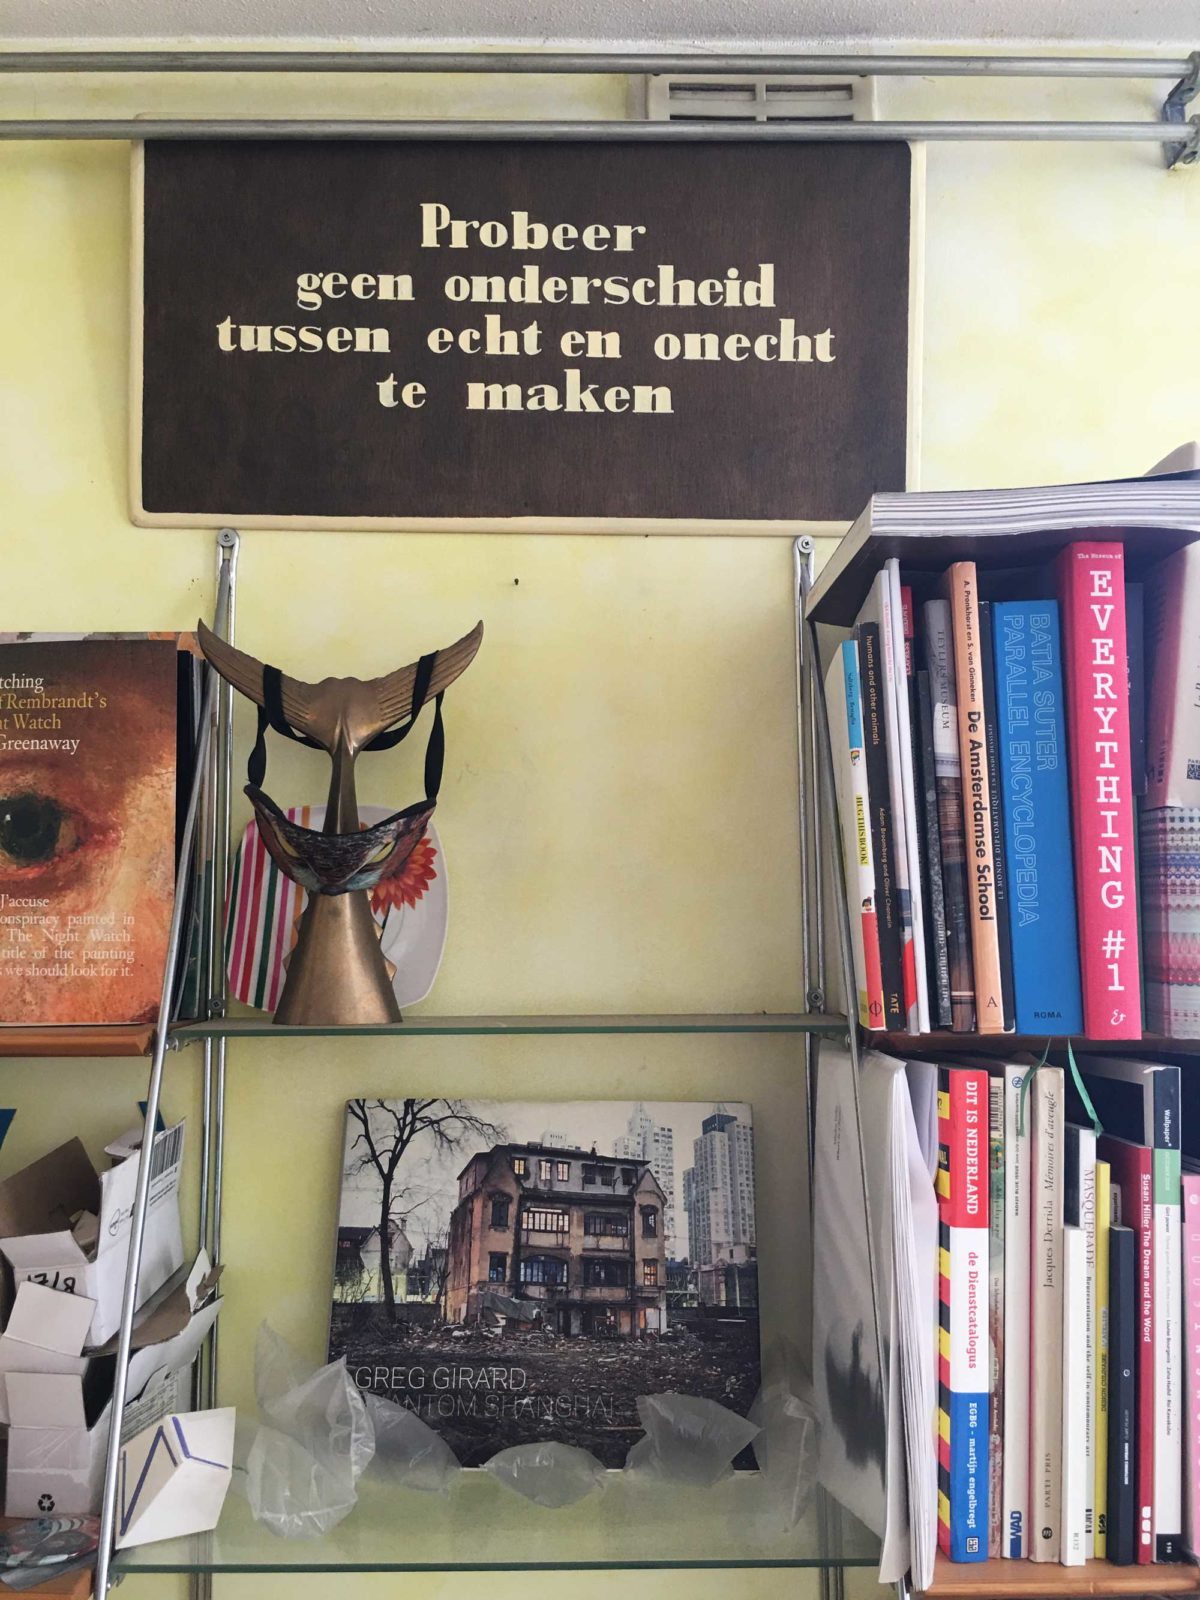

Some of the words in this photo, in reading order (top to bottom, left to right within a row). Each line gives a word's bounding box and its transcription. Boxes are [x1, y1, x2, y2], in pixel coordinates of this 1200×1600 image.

[420, 203, 646, 251] Probeer
[297, 272, 415, 311] geen
[444, 263, 776, 307] onderscheid
[216, 315, 391, 353] tussen
[427, 314, 542, 355] echt
[560, 330, 622, 358] en
[654, 318, 836, 362] onecht
[376, 372, 427, 408] te
[466, 368, 674, 413] maken
[963, 591, 973, 630] Pronkhorst
[866, 635, 876, 668] humans
[966, 631, 973, 641] en
[1029, 613, 1053, 685] BATIA
[869, 670, 877, 687] and
[968, 668, 977, 702] Ginneken
[1003, 614, 1029, 734] PARALLEL
[7, 692, 107, 709] Rembrandt's
[870, 688, 878, 710] other
[940, 682, 950, 729] MUSEUM
[14, 713, 62, 729] Watch
[871, 712, 880, 745] animals
[968, 711, 981, 733] De
[1033, 690, 1058, 771] SUTER
[1089, 570, 1126, 909] EVERYTHING
[969, 739, 988, 858] Amsterdamse
[991, 790, 1001, 853] DIPLOMATIQUE
[1009, 741, 1040, 927] ENCYCLOPEDIA
[880, 828, 889, 863] Broomberg
[977, 864, 994, 920] School
[68, 913, 115, 928] painted
[123, 912, 135, 925] in
[7, 929, 33, 942] The
[42, 929, 79, 945] Night
[2, 946, 26, 959] title
[33, 946, 48, 959] of
[54, 946, 74, 959] the
[82, 948, 135, 964] painting
[5, 967, 23, 976] we
[25, 963, 68, 977] should
[71, 963, 98, 977] look
[101, 963, 118, 977] for
[1102, 929, 1126, 991] #1
[890, 993, 900, 1014] TATE
[966, 1081, 978, 1105] DIT
[966, 1110, 978, 1123] IS
[1043, 1090, 1056, 1138] d'aveugle
[966, 1128, 978, 1214] NEDERLAND
[1043, 1143, 1054, 1191] Mémoires
[1143, 1173, 1151, 1201] Susan
[1043, 1200, 1054, 1242] Derrida
[1143, 1204, 1151, 1228] Hiller
[1143, 1230, 1151, 1247] The
[968, 1252, 979, 1267] de
[1043, 1247, 1056, 1288] Jacques
[1143, 1249, 1151, 1278] Dream
[1143, 1281, 1152, 1299] and
[966, 1271, 979, 1369] Dienstcatalogus
[1143, 1300, 1152, 1315] the
[1143, 1317, 1152, 1342] Word
[355, 1366, 425, 1390] GREG
[433, 1366, 527, 1390] GIRARD
[484, 1394, 613, 1418] SHANGHAI
[969, 1403, 978, 1428] EGBG
[966, 1438, 978, 1474] martijn
[966, 1477, 978, 1528] engelbregt
